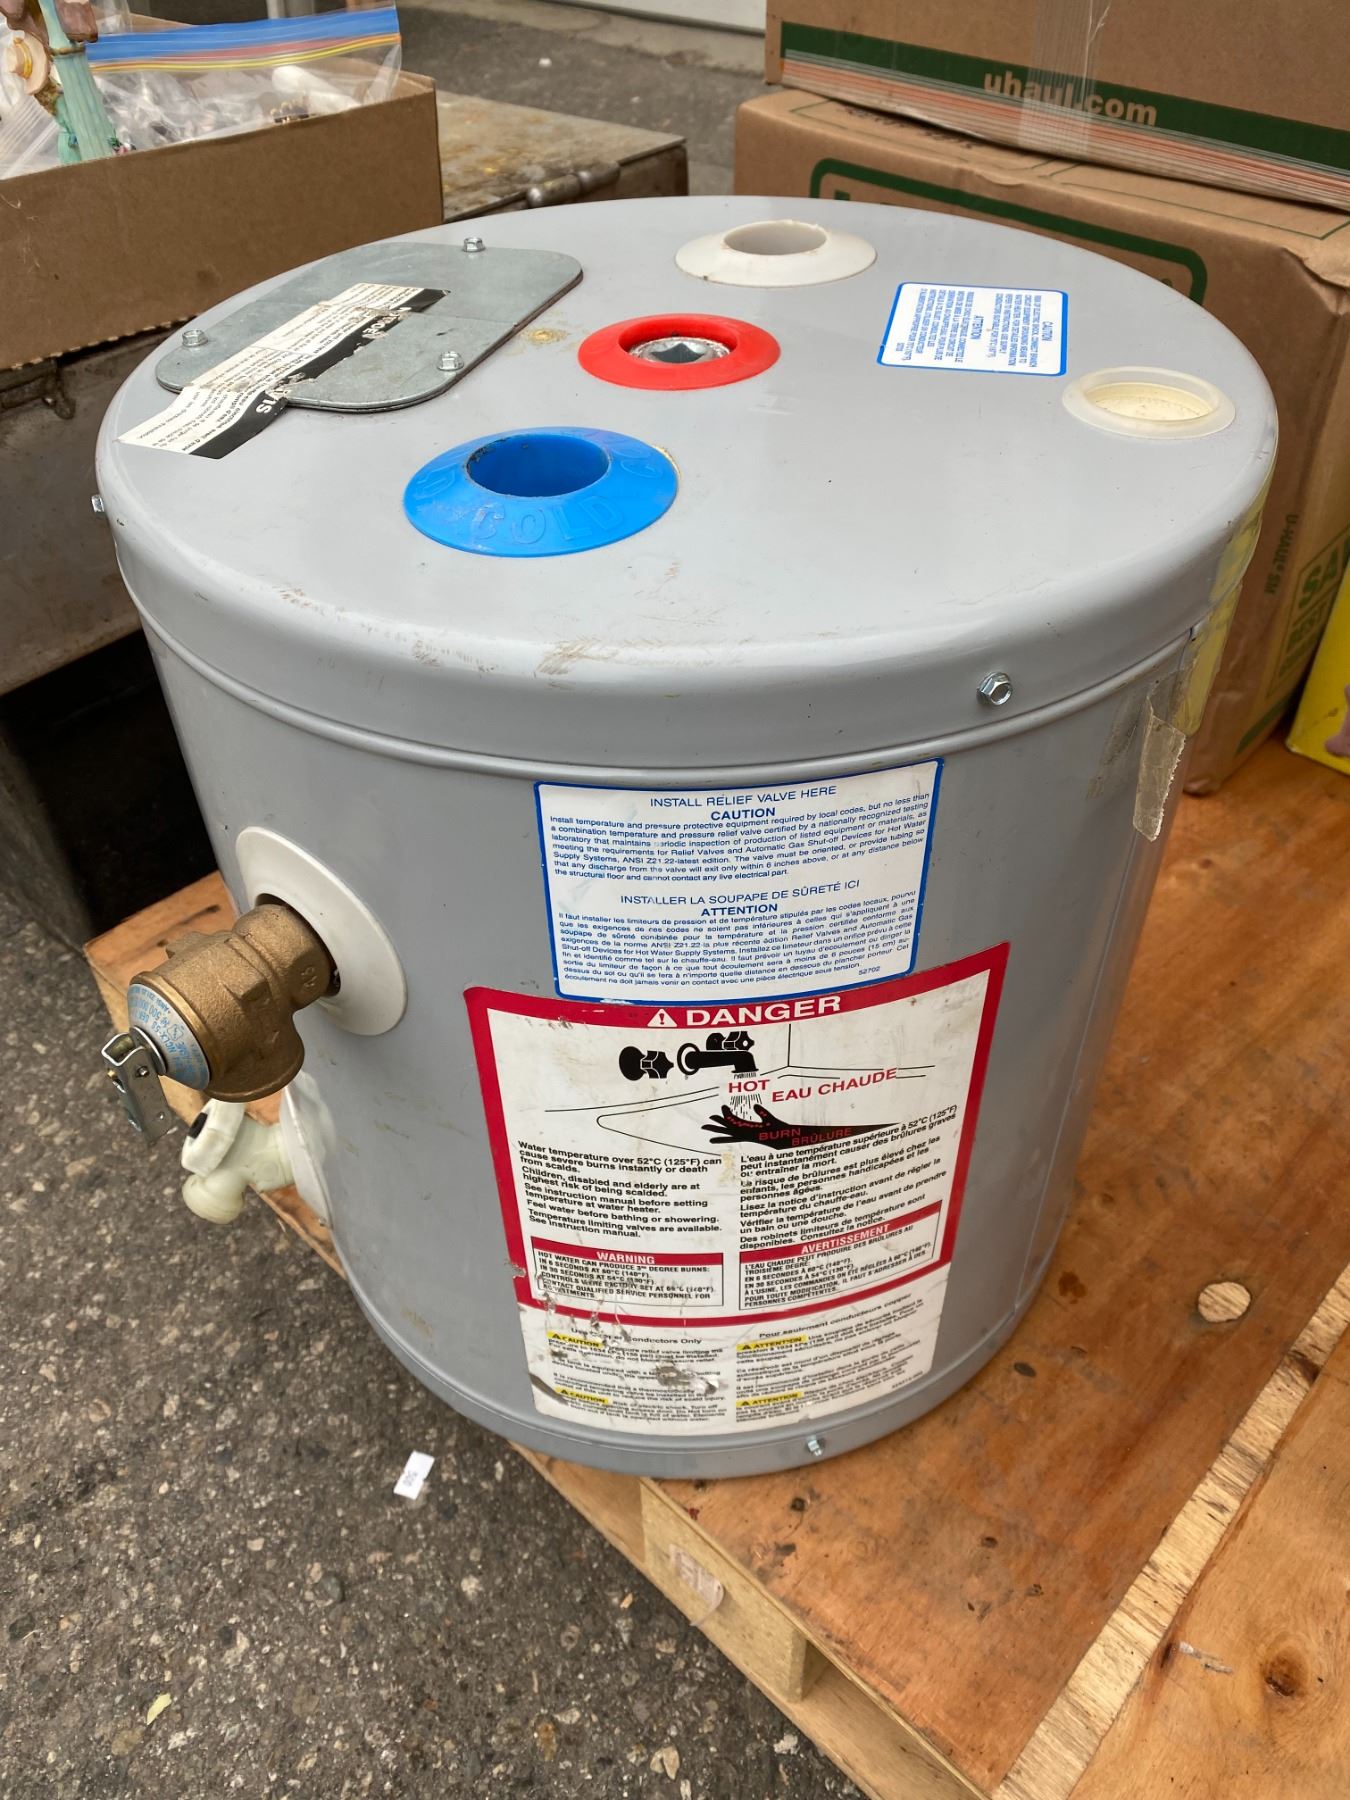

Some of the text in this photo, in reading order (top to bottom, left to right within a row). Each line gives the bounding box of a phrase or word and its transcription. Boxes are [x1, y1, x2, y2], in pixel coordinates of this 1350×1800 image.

[983, 70, 1157, 126] uhaul.com
[471, 496, 624, 545] COLD
[650, 785, 837, 807] INSTALL RELIEF VALVE HERE
[550, 815, 574, 824] Install
[575, 818, 624, 828] temperature
[627, 821, 643, 829] and
[644, 822, 681, 830] pressure
[683, 822, 723, 830] protective
[726, 819, 769, 829] equipment
[771, 815, 805, 825] required
[806, 812, 817, 821] by
[819, 810, 838, 818] local
[868, 803, 881, 811] but
[894, 797, 910, 806] less
[912, 793, 930, 801] than
[711, 807, 775, 821] CAUTION
[620, 895, 687, 905] INSTALLER
[690, 896, 706, 904] LA
[708, 893, 768, 904] SOUPAPE
[772, 891, 789, 900] DE
[844, 879, 860, 889] ICI
[701, 903, 778, 916] ATTENTION
[686, 995, 841, 1026] DANGER
[728, 1079, 770, 1093] HOT
[771, 1067, 898, 1102] EAU CHAUDE
[740, 1161, 763, 1172] peut
[839, 1143, 870, 1155] causer
[872, 1138, 889, 1148] des
[928, 1114, 956, 1132] graves
[759, 1127, 801, 1141] BURN
[518, 1140, 546, 1153] Water
[548, 1146, 610, 1163] temperature
[612, 1156, 634, 1164] over
[519, 1150, 708, 1175] cause severe burns instantly or death
[520, 1156, 543, 1167] from
[740, 1154, 766, 1164] L'eau
[776, 1150, 794, 1159] une
[754, 1175, 786, 1187] risque
[788, 1173, 800, 1181] de
[843, 1162, 858, 1171] est
[859, 1156, 879, 1171] plus
[906, 1141, 927, 1154] chez
[928, 1136, 941, 1146] les
[781, 1182, 796, 1190] les
[797, 1172, 847, 1190] personnes
[906, 1153, 915, 1161] et
[917, 1147, 929, 1157] les
[802, 1161, 810, 1170] la
[522, 1172, 560, 1187] highest
[561, 1179, 580, 1190] risk
[582, 1183, 592, 1192] of
[594, 1185, 623, 1196] being
[567, 1174, 610, 1186] disabled
[612, 1179, 632, 1188] and
[634, 1181, 668, 1191] elderly
[740, 1201, 765, 1212] Lisez
[768, 1200, 776, 1208] la
[778, 1196, 807, 1207] notice
[810, 1184, 867, 1203] d'instruction
[869, 1175, 896, 1187] avant
[897, 1170, 905, 1179] de
[933, 1157, 941, 1166] la
[524, 1182, 708, 1208] See instruction manual before setting
[525, 1189, 583, 1207] temperature
[585, 1200, 596, 1208] at
[597, 1201, 625, 1211] water
[740, 1190, 790, 1203] personnes
[799, 1203, 811, 1211] du
[527, 1198, 547, 1210] Feel
[549, 1203, 575, 1215] water
[577, 1206, 609, 1219] before
[611, 1212, 648, 1224] bathing
[651, 1215, 662, 1223] or
[528, 1208, 586, 1225] Temperature
[588, 1218, 624, 1231] limiting
[626, 1224, 656, 1232] valves
[740, 1234, 758, 1243] Des
[760, 1228, 798, 1241] robinets
[800, 1222, 839, 1235] limiteurs
[841, 1219, 852, 1227] de
[907, 1194, 926, 1207] sont
[529, 1215, 547, 1225] See
[549, 1218, 600, 1234] instruction
[754, 1224, 775, 1233] bain
[777, 1223, 790, 1231] ou
[792, 1220, 809, 1228] une
[800, 1226, 844, 1241] Consultez
[847, 1224, 854, 1232] la
[801, 1224, 891, 1254] AVERTISSEMENT
[596, 1251, 655, 1264] WARNING
[628, 1336, 702, 1345] onductors Only
